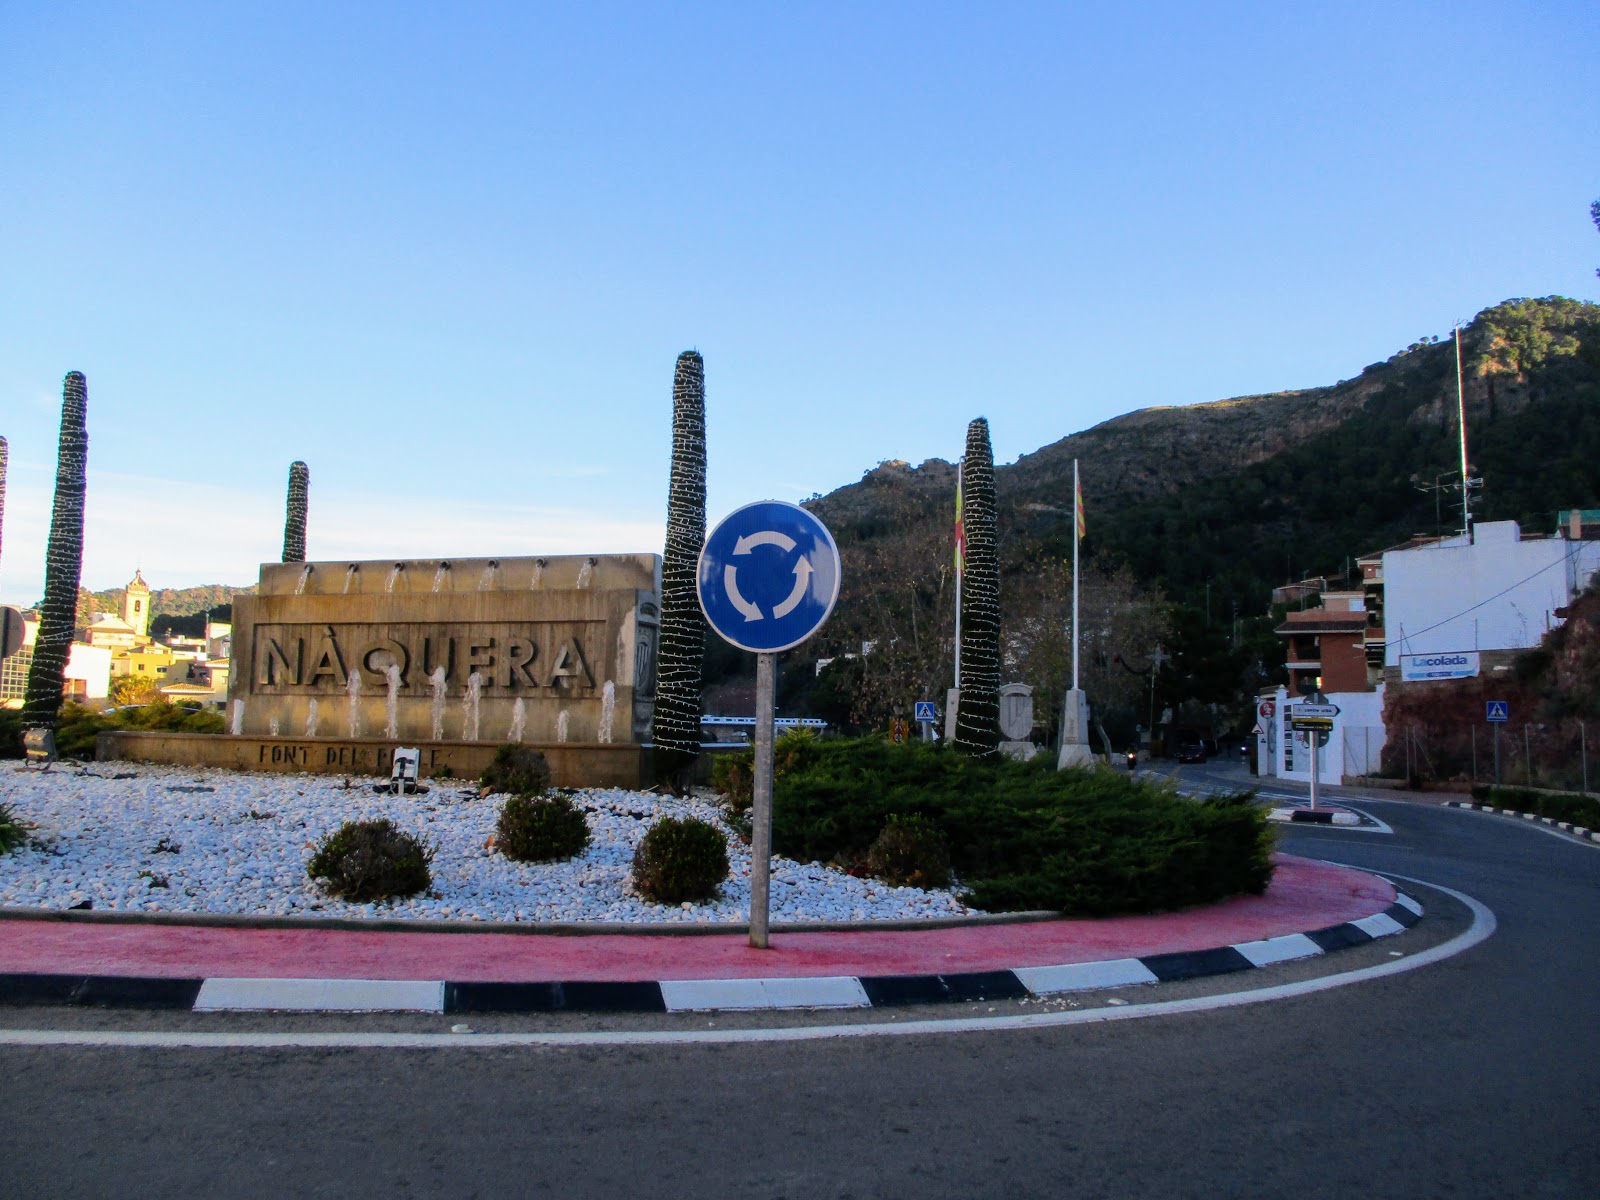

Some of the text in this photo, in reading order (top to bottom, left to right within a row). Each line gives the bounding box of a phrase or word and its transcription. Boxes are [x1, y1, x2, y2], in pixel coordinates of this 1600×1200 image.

[260, 625, 597, 688] NÀQUERA
[259, 744, 443, 769] FONT DEL PLE
